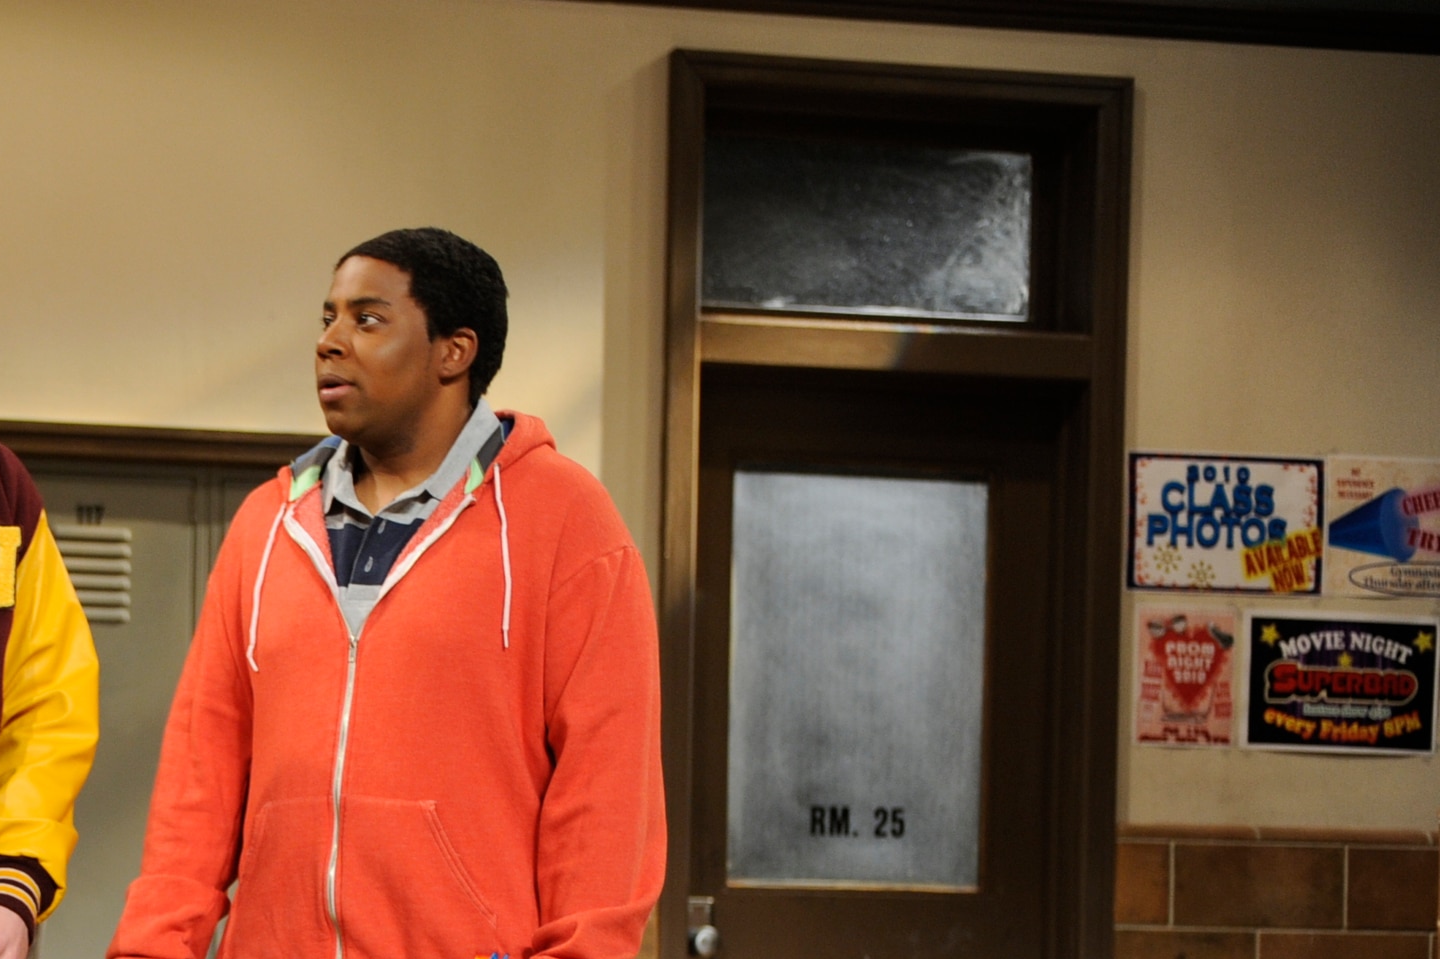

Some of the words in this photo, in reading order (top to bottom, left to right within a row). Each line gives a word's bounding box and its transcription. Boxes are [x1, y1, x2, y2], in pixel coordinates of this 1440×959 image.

[75, 503, 105, 525] 117
[1160, 481, 1275, 516] CLASS
[1146, 513, 1287, 549] PHOTOS
[1407, 527, 1440, 550] TR
[1244, 529, 1322, 577] AVAILABLE
[1273, 560, 1307, 592] NOW
[1278, 631, 1345, 658] MOVIE
[1350, 631, 1412, 664] NIGHT
[1264, 707, 1317, 740] every
[1321, 713, 1379, 743] Friday
[810, 806, 859, 838] RM.
[874, 807, 906, 839] 25
